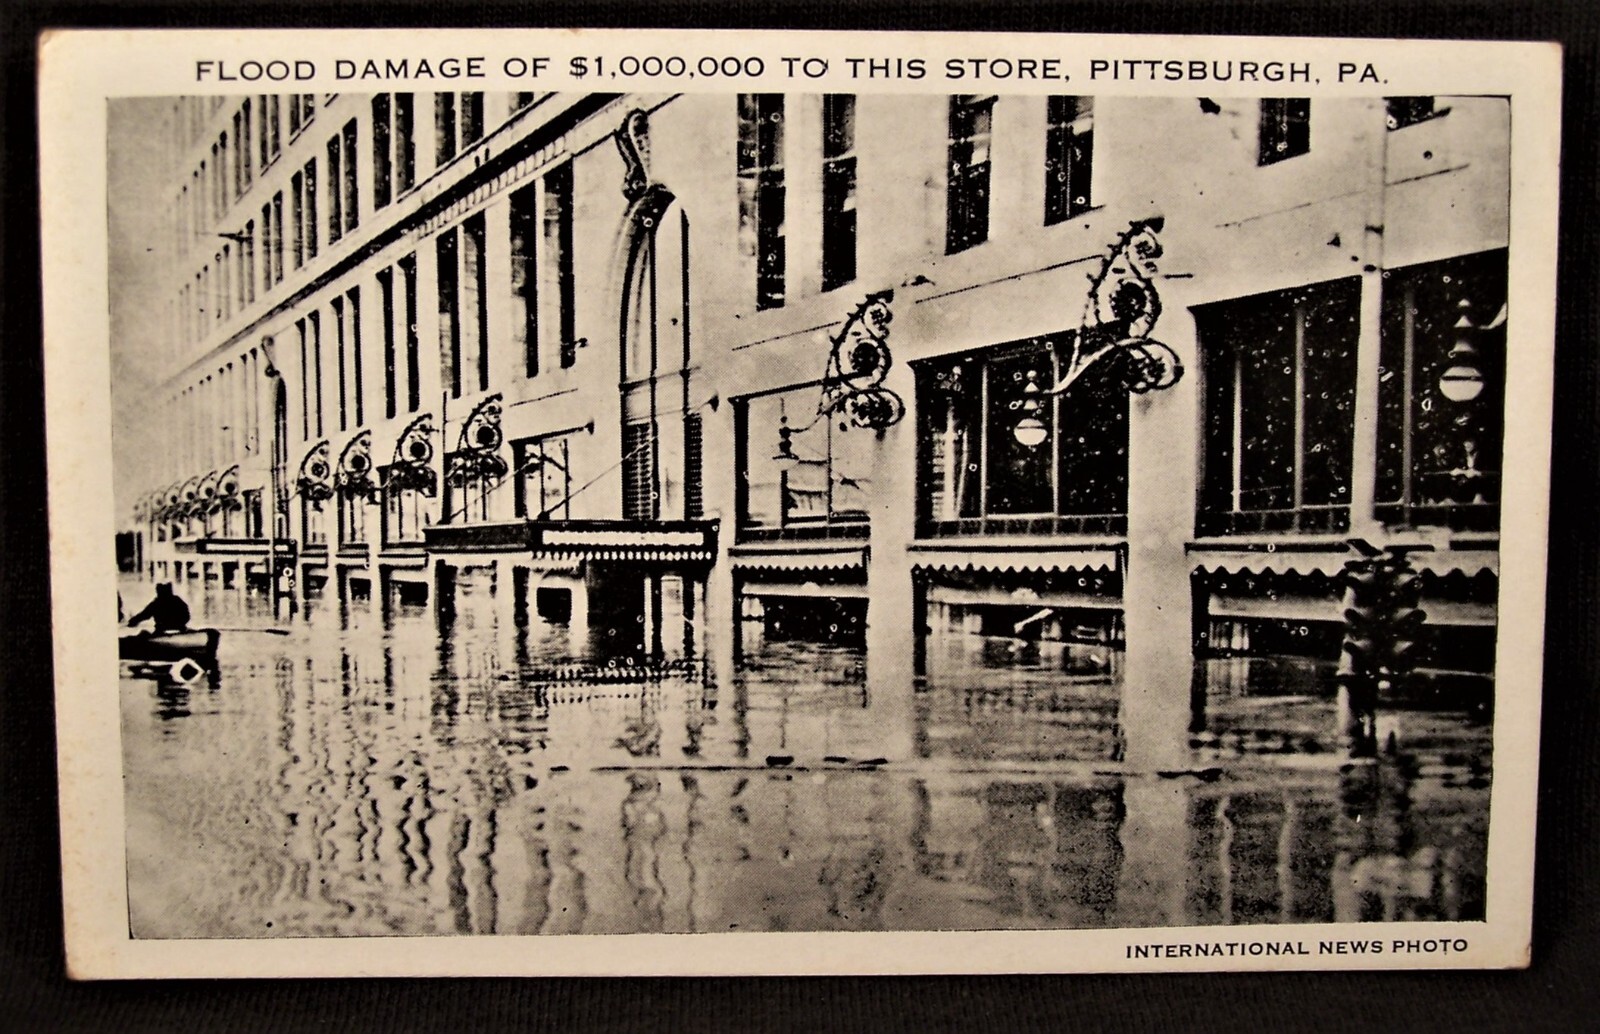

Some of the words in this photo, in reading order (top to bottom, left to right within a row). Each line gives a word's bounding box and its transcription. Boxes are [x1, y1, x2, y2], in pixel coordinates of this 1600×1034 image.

[196, 60, 316, 81] FLOOD
[335, 57, 486, 80] DAMAGE
[503, 57, 550, 78] OF
[569, 56, 765, 78] $1,000,000
[781, 57, 829, 79] TO
[845, 58, 927, 80] THIS
[945, 58, 1070, 82] STORE,
[1090, 59, 1320, 84] PITTSBURGH,
[1338, 62, 1389, 84] PA.
[1126, 941, 1310, 959] INTERNATIONAL
[1319, 940, 1383, 955] NEWS
[1392, 938, 1468, 955] PHOTO
